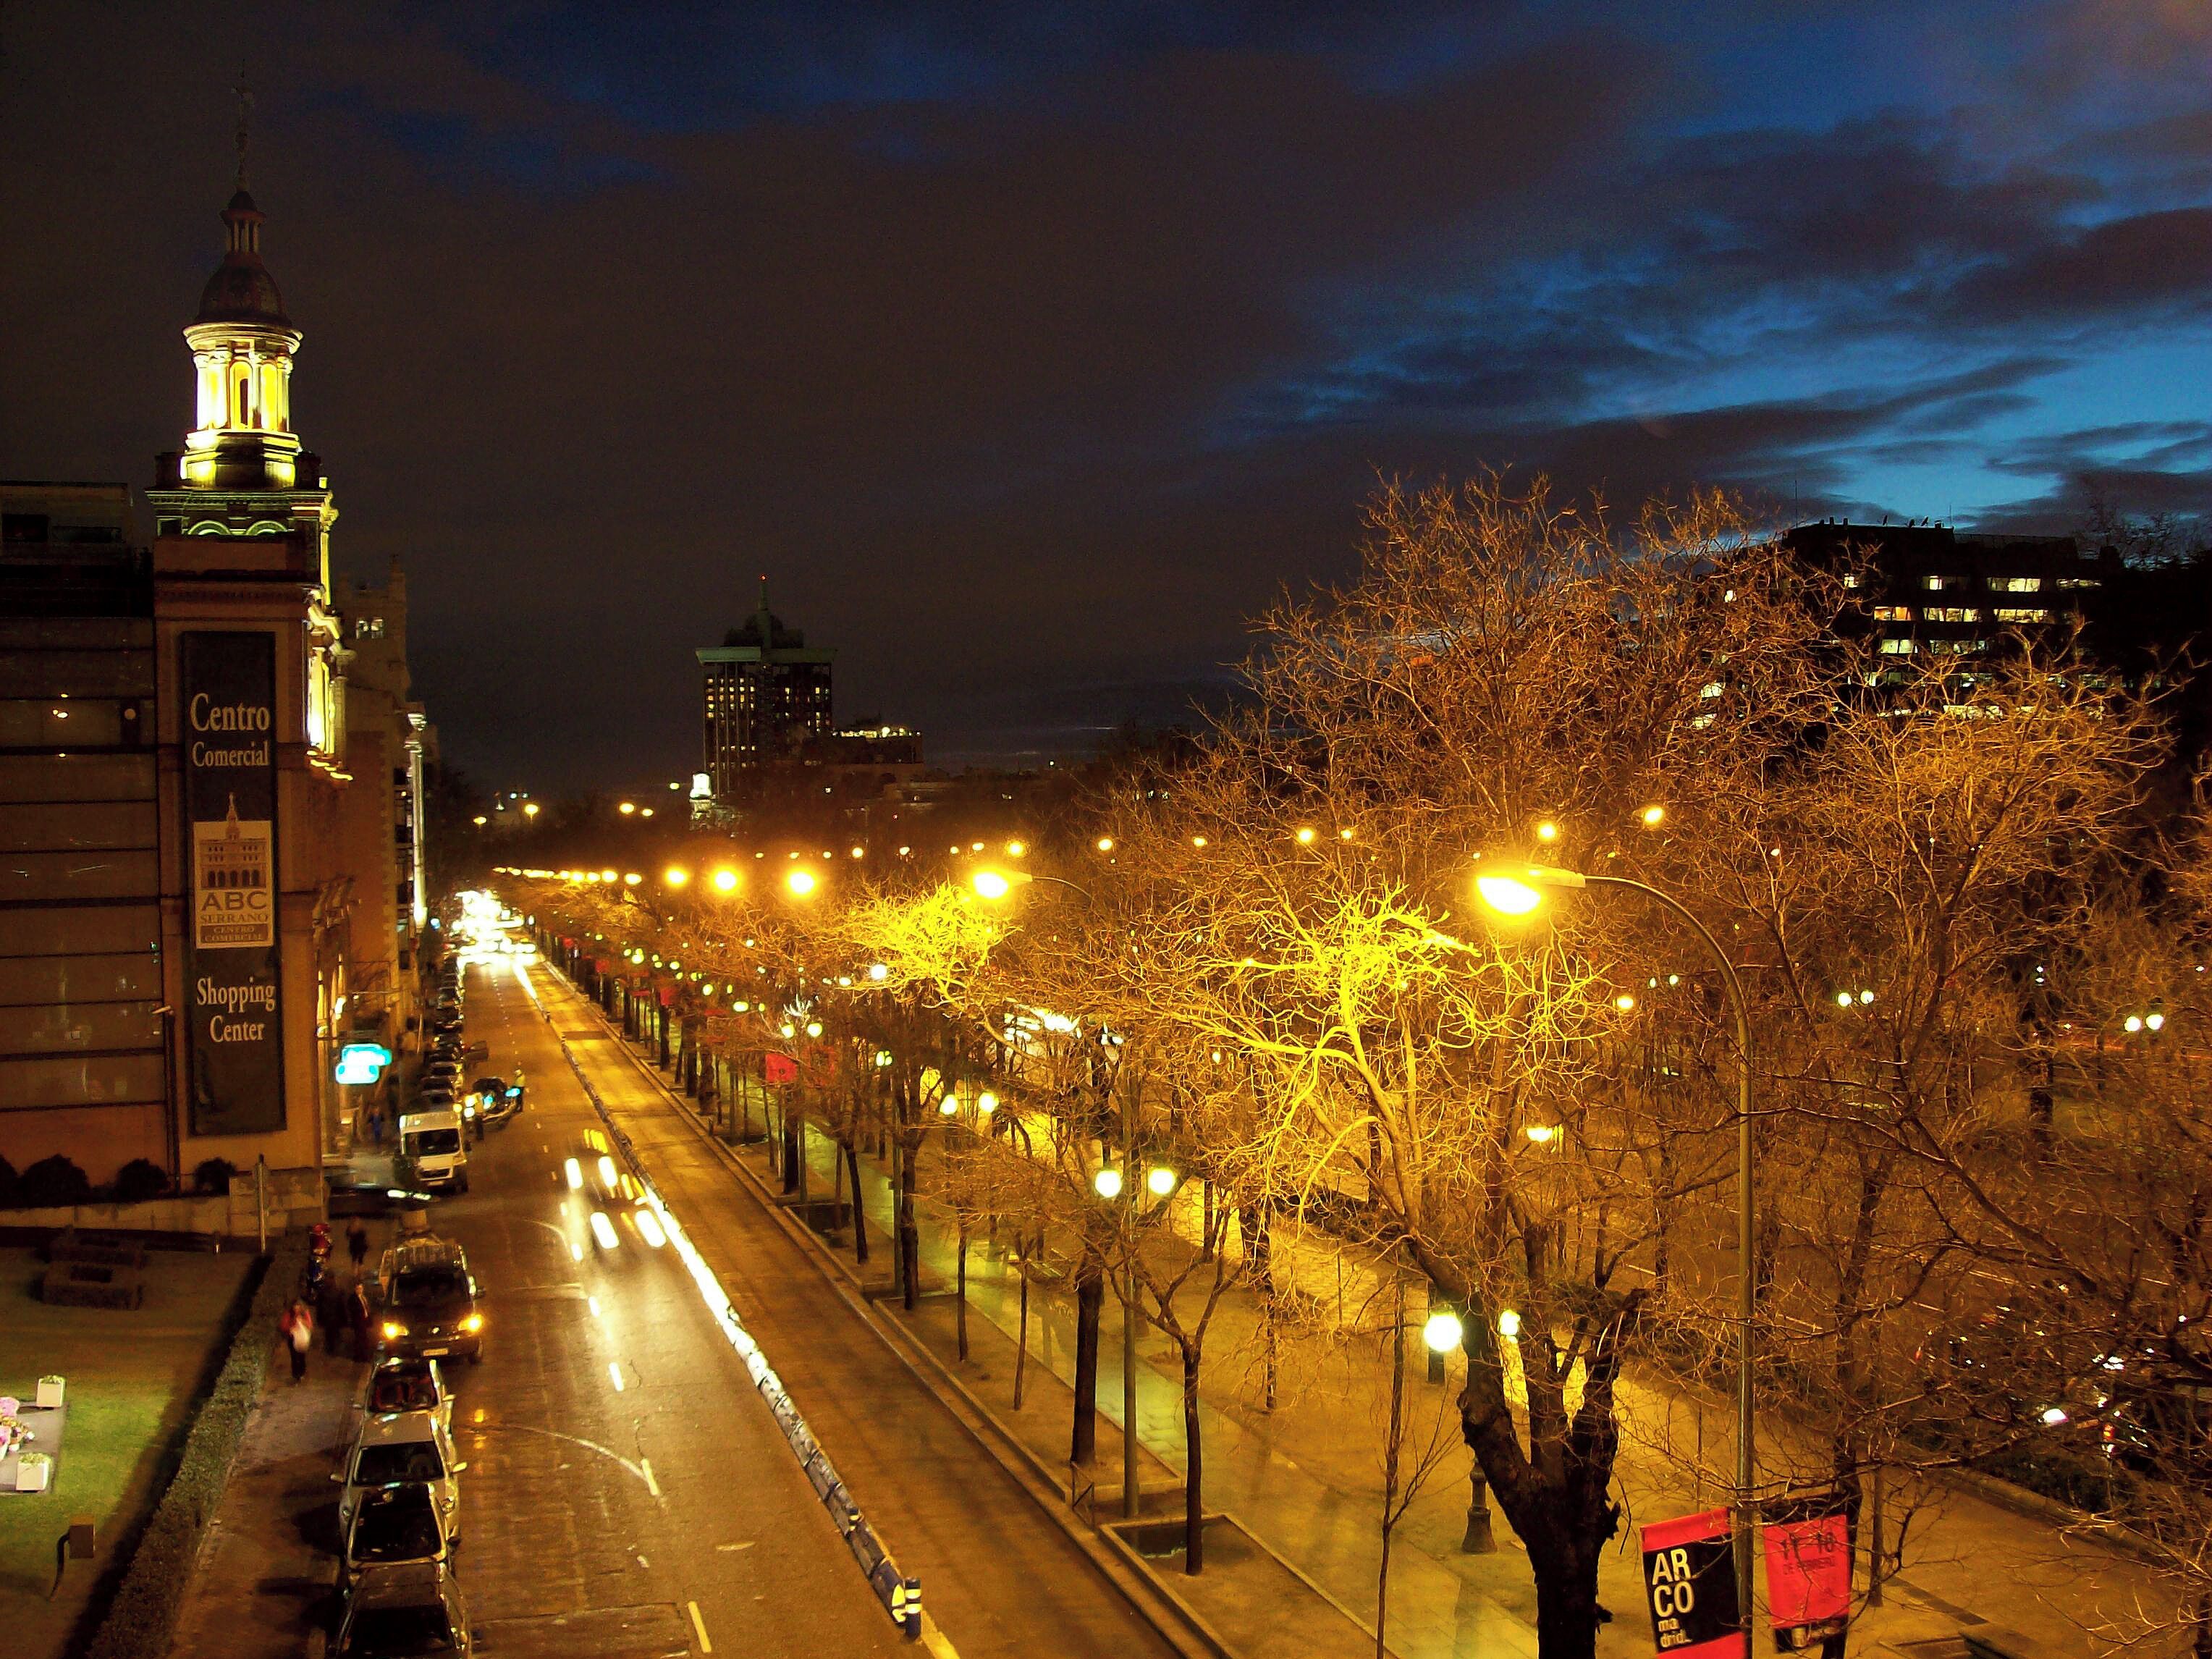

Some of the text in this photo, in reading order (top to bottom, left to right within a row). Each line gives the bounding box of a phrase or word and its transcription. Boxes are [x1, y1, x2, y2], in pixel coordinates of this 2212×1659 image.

[190, 692, 271, 732] Centro
[192, 740, 271, 767] Comercial
[201, 891, 267, 911] ABC
[200, 913, 269, 924] SERRANO
[196, 976, 276, 1012] Shopping
[210, 1015, 265, 1042] Center
[1652, 1548, 1692, 1585] AR
[1653, 1581, 1695, 1618] CO
